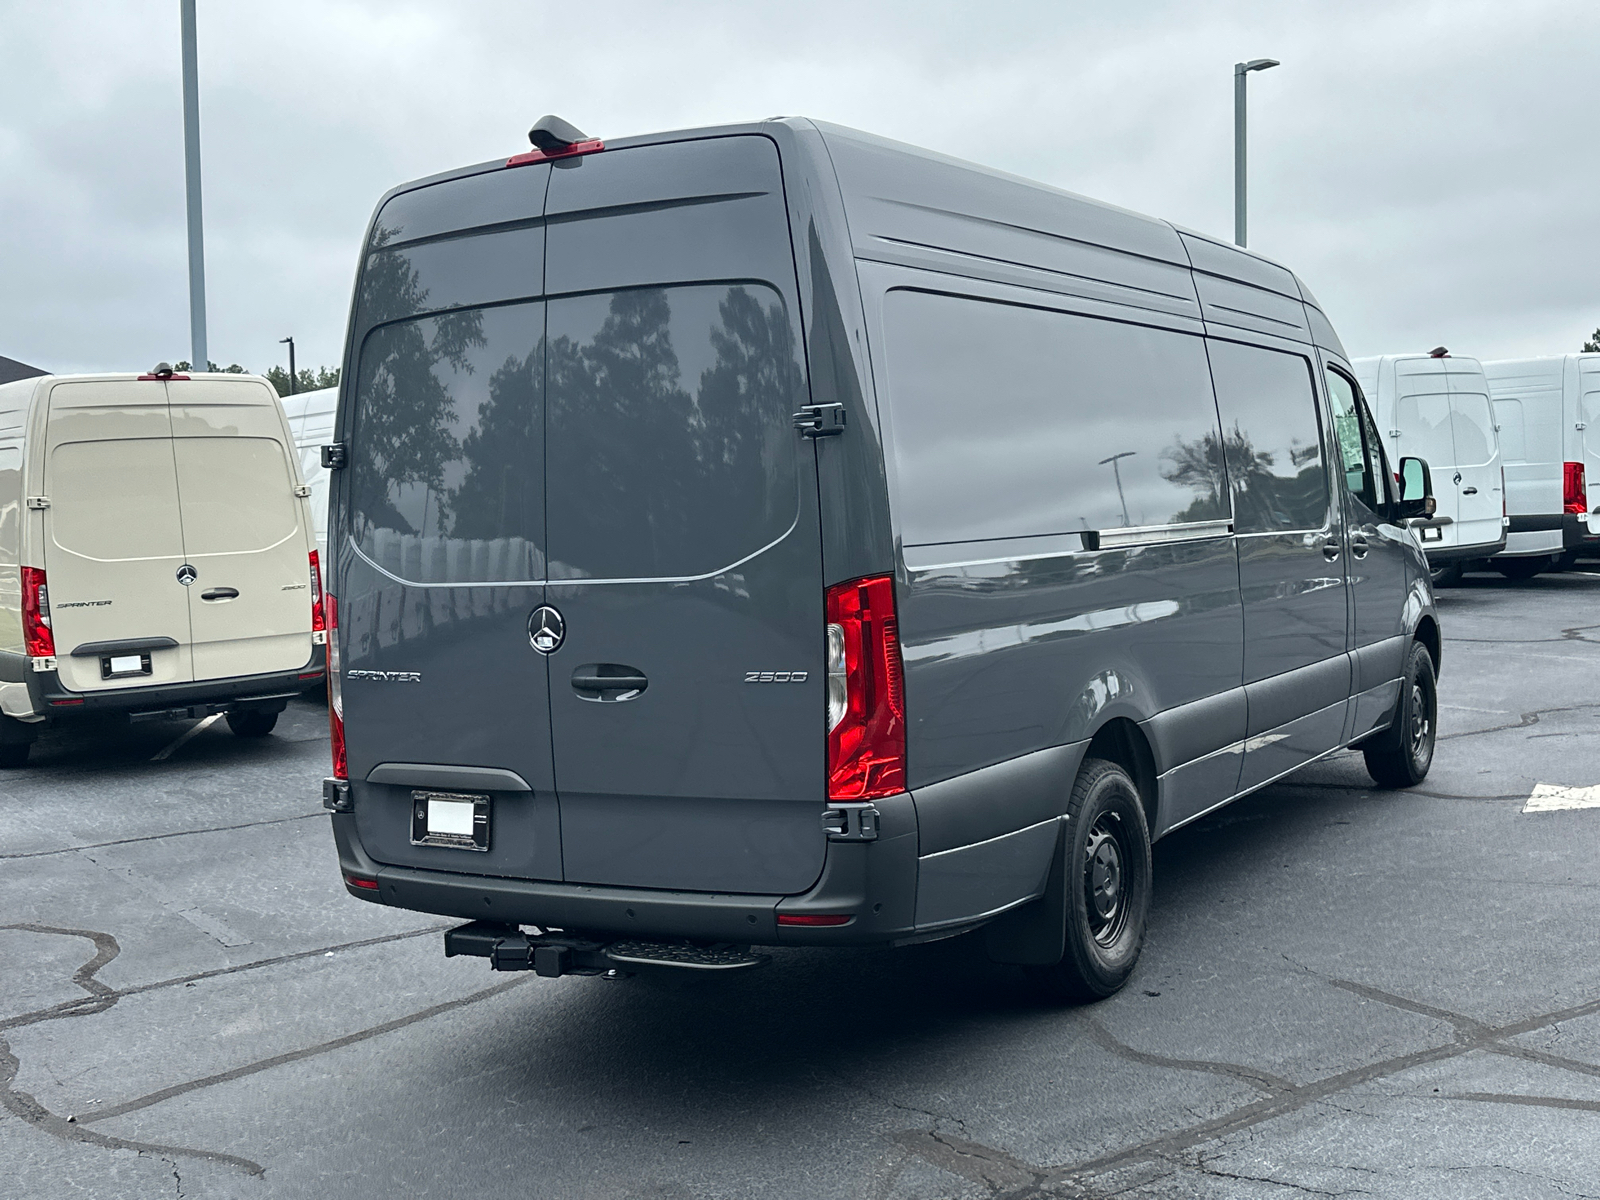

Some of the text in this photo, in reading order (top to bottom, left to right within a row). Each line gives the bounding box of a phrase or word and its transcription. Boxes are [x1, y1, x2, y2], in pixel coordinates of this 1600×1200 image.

[56, 600, 113, 609] SPRINTER
[347, 669, 421, 682] SPRINTER
[744, 671, 808, 682] 2500
